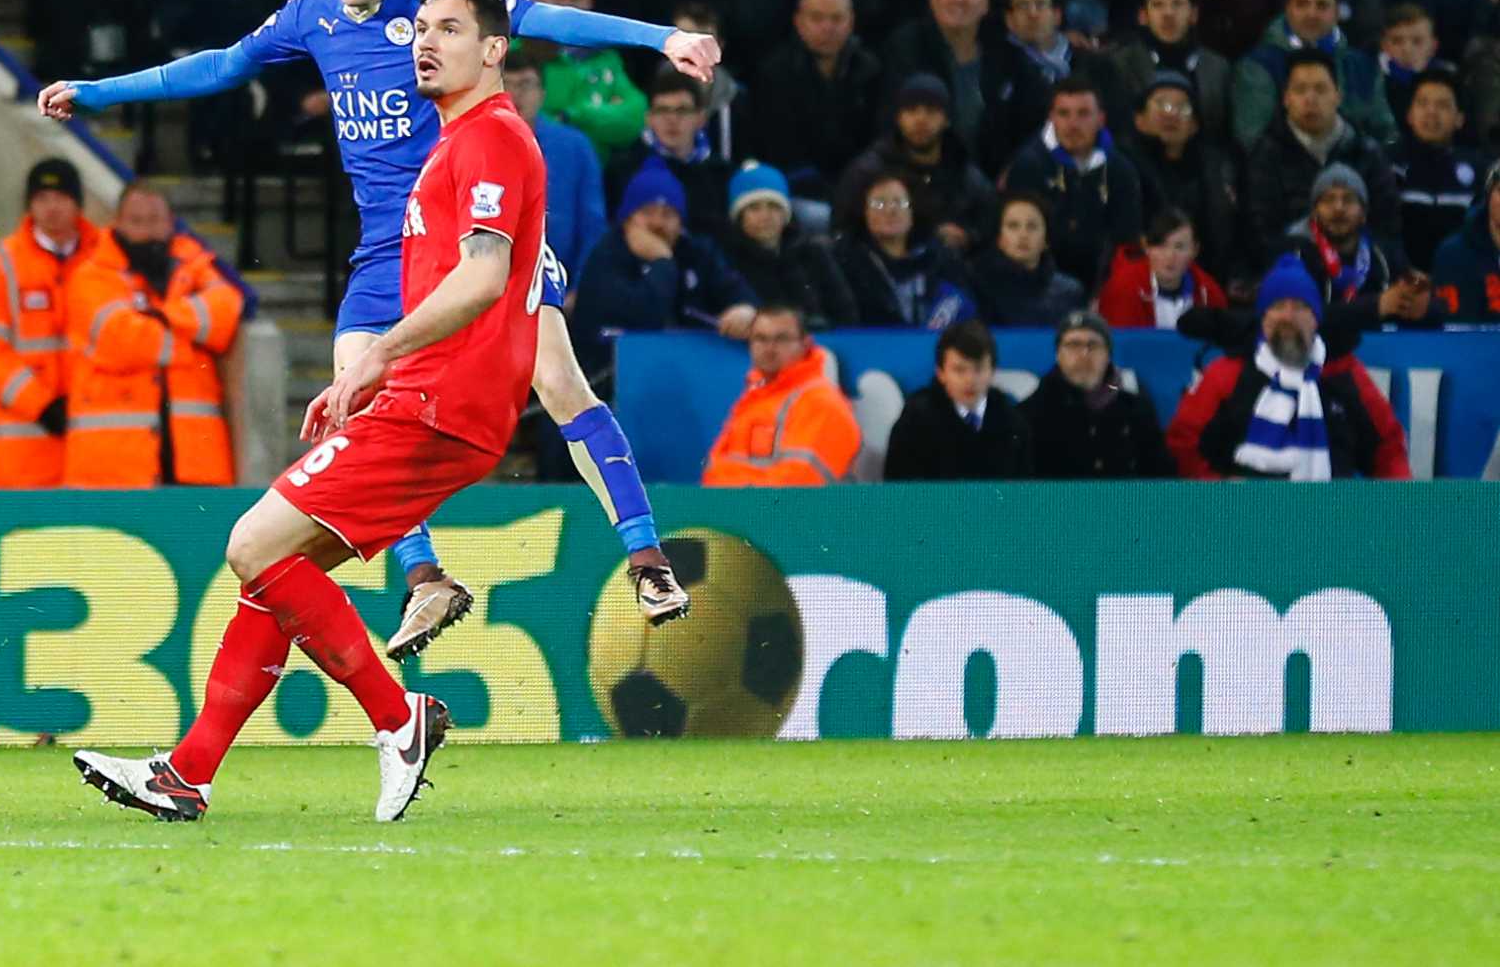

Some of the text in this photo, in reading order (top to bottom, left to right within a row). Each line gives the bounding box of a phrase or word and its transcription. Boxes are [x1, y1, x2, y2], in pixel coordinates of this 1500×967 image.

[330, 89, 409, 119] KING
[338, 118, 412, 141] POWER
[303, 435, 350, 475] 6
